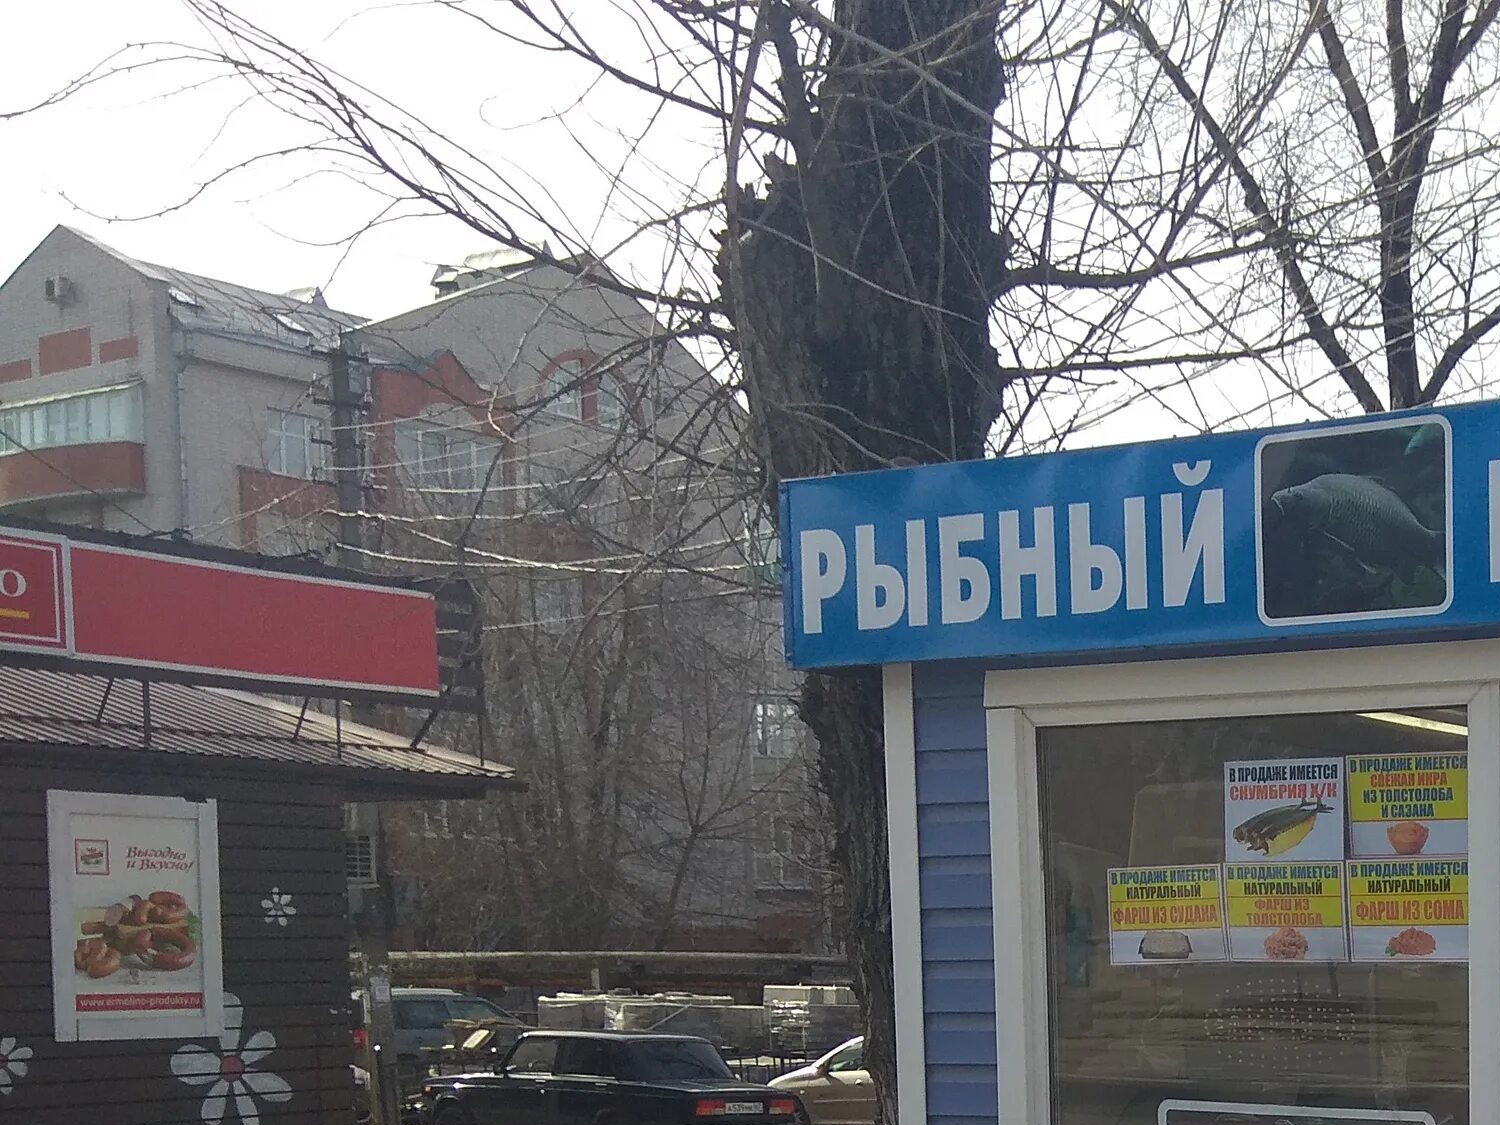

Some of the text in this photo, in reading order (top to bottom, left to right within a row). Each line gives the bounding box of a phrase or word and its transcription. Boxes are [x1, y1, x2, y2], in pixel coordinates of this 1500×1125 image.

[799, 459, 1227, 634] РЫБНЫЙ
[1350, 755, 1468, 774] В ПРОДАЖЕ ИМЕЕТСЯ
[1229, 764, 1339, 784] В ПРОДАЖЕ ИМЕЕТСЯ
[1370, 771, 1448, 788] СВЕЖАЯ ИКРА
[1229, 784, 1308, 801] СКУМБРИЯ
[1363, 787, 1454, 803] ИЗ ТОЛСТОЛОБА
[1381, 804, 1435, 818] И САЗАНА
[126, 846, 187, 861] Выгодно
[126, 859, 136, 869] и
[1350, 861, 1468, 879] В ПРОДАЖЕ ИМЕЕТСЯ
[1111, 868, 1216, 886] В ПРОДАЖЕ ИМЕЕТСЯ
[1227, 865, 1338, 881] В ПРОДАЖЕ ИМЕЕТСЯ
[1126, 882, 1201, 900] НАТУРАЛЬНЫЙ
[1243, 879, 1324, 896] НАТУРАЛЬНЫЙ
[1367, 876, 1451, 894] НАТУРАЛЬНЫЙ
[1254, 898, 1310, 912] ФАРШ ИЗ
[1356, 899, 1465, 921] ФАРШ ИЗ СОМА
[1113, 904, 1218, 925] ФАРШ ИЗ СУДАКА
[1246, 912, 1324, 927] ТОЛСТОЛОБА
[80, 995, 200, 1008] www.ermolino-produkty.ru
